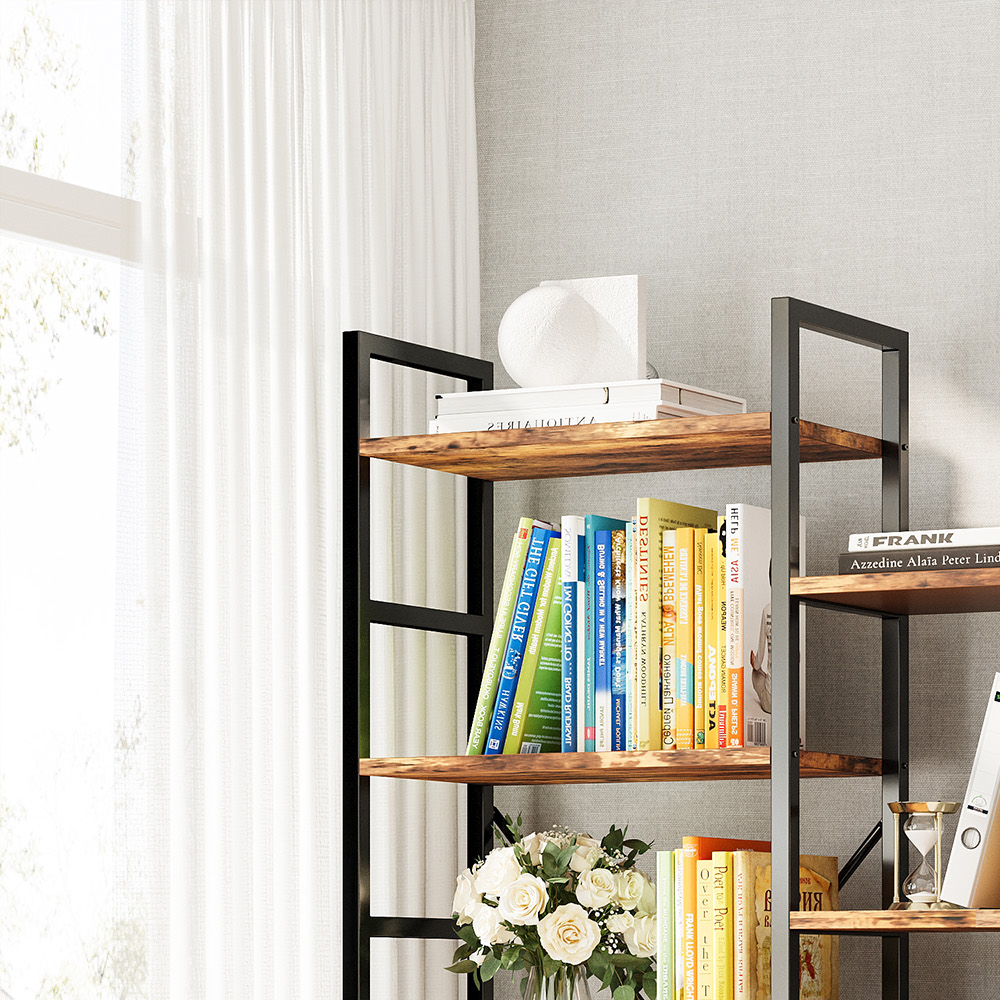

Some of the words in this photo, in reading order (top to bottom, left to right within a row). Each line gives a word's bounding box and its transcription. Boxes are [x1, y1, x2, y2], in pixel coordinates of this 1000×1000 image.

[872, 533, 954, 547] FRANK
[850, 558, 903, 570] Azzedine
[906, 554, 938, 568] Alaïa
[941, 554, 971, 567] Peter
[714, 866, 728, 889] Poet
[686, 913, 694, 940] FRANK
[714, 907, 728, 931] Poet
[686, 941, 694, 968] LLOYD
